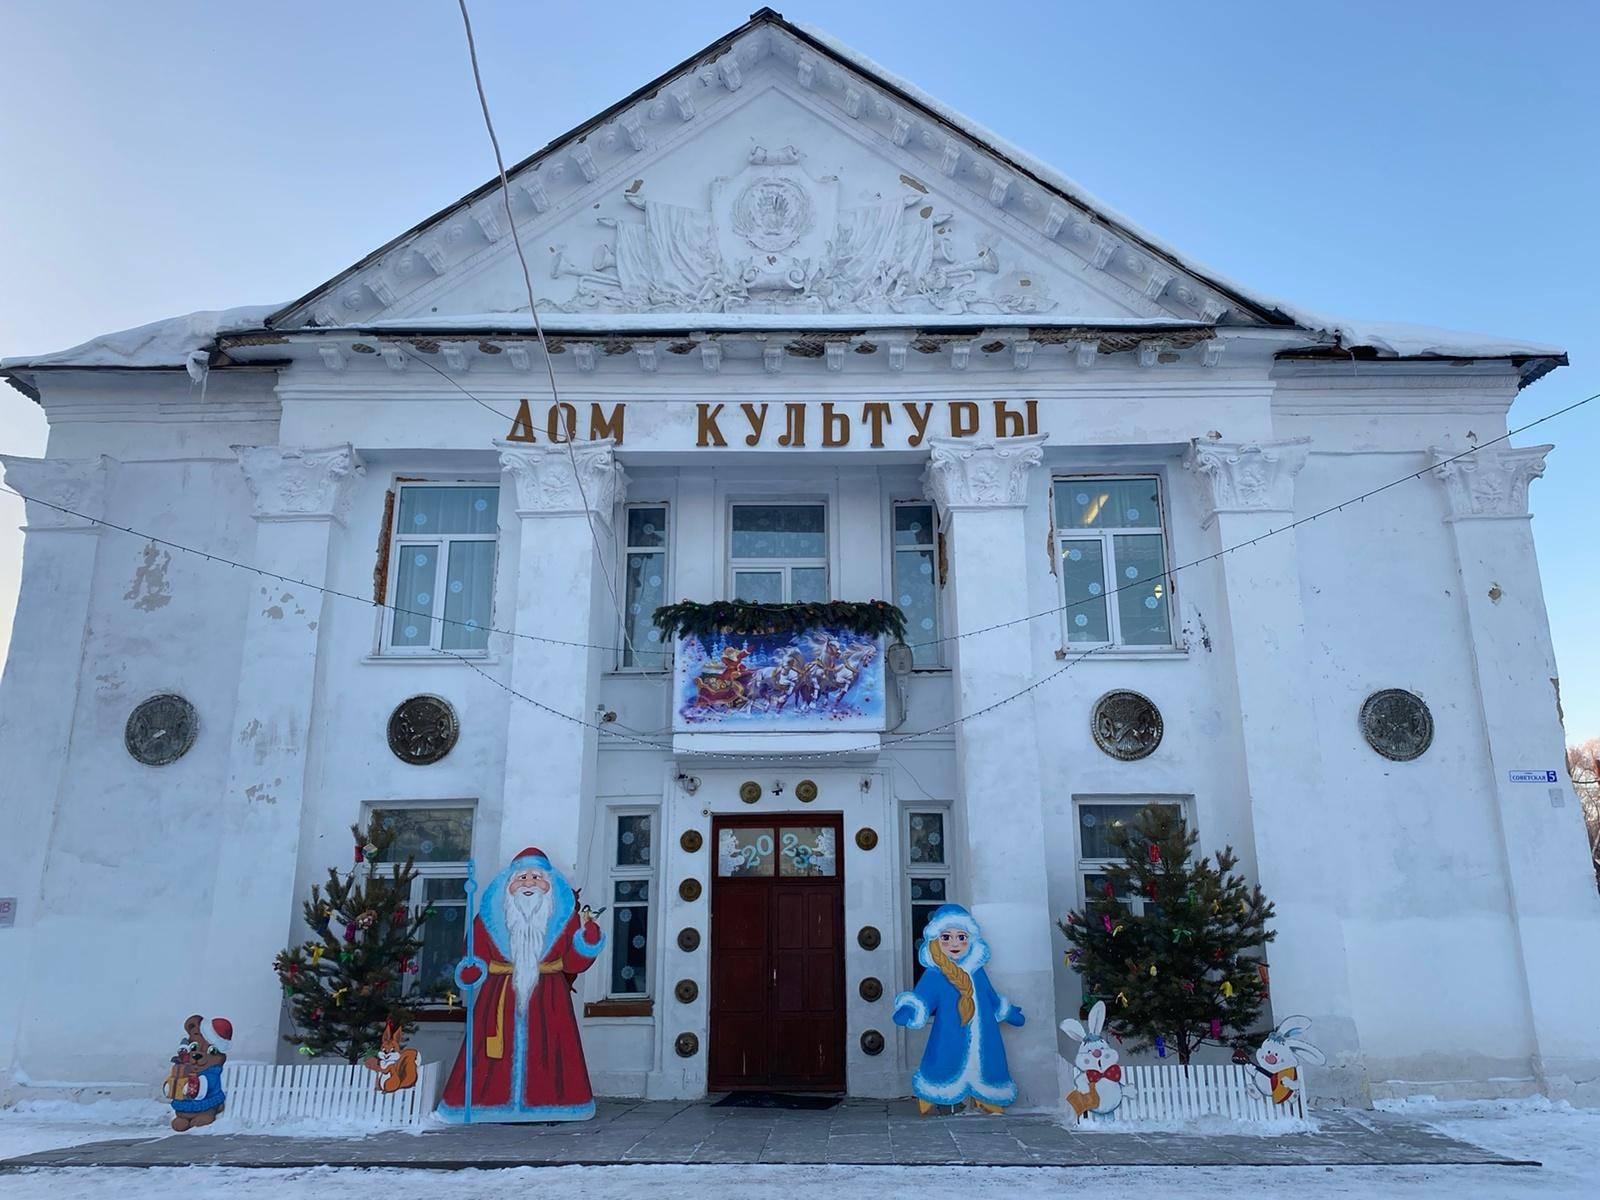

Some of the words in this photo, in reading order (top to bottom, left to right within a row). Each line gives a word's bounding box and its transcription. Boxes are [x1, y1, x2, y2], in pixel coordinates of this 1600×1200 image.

[506, 399, 627, 445] ДОМ
[696, 401, 1038, 447] КУЛЬТУРЫ
[1548, 771, 1556, 782] 5
